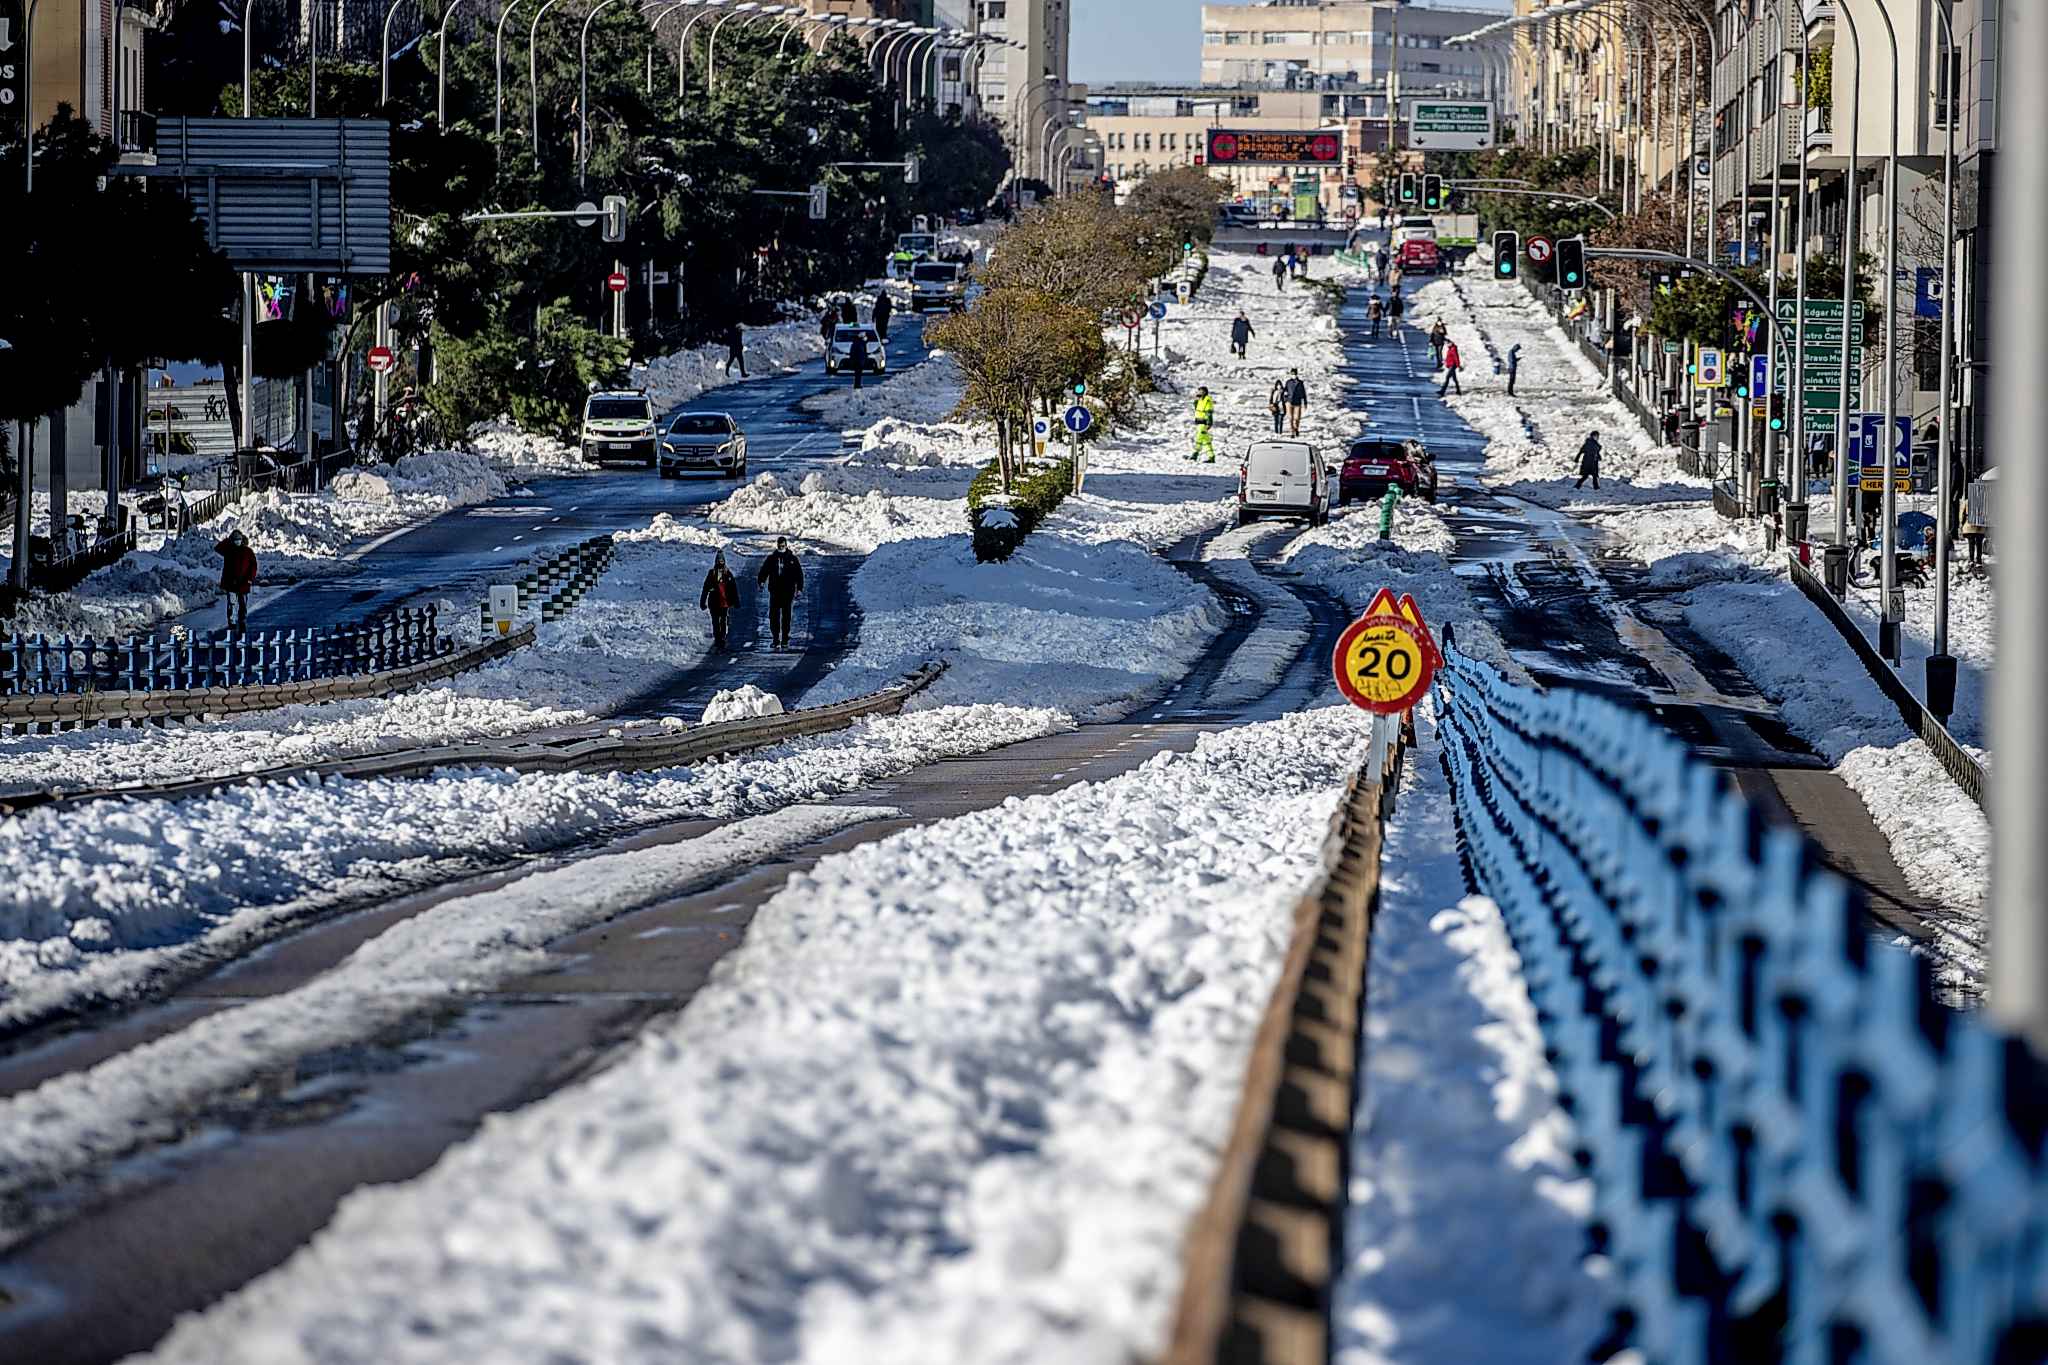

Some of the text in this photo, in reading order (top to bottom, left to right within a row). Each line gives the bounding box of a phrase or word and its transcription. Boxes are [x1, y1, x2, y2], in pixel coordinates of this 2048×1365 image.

[1804, 308, 1830, 318] Edgar
[1824, 333, 1860, 341] Camos
[1829, 354, 1860, 363] Mulo
[1803, 376, 1823, 384] eina
[1865, 481, 1905, 489] HERNI
[1357, 646, 1411, 680] 20
